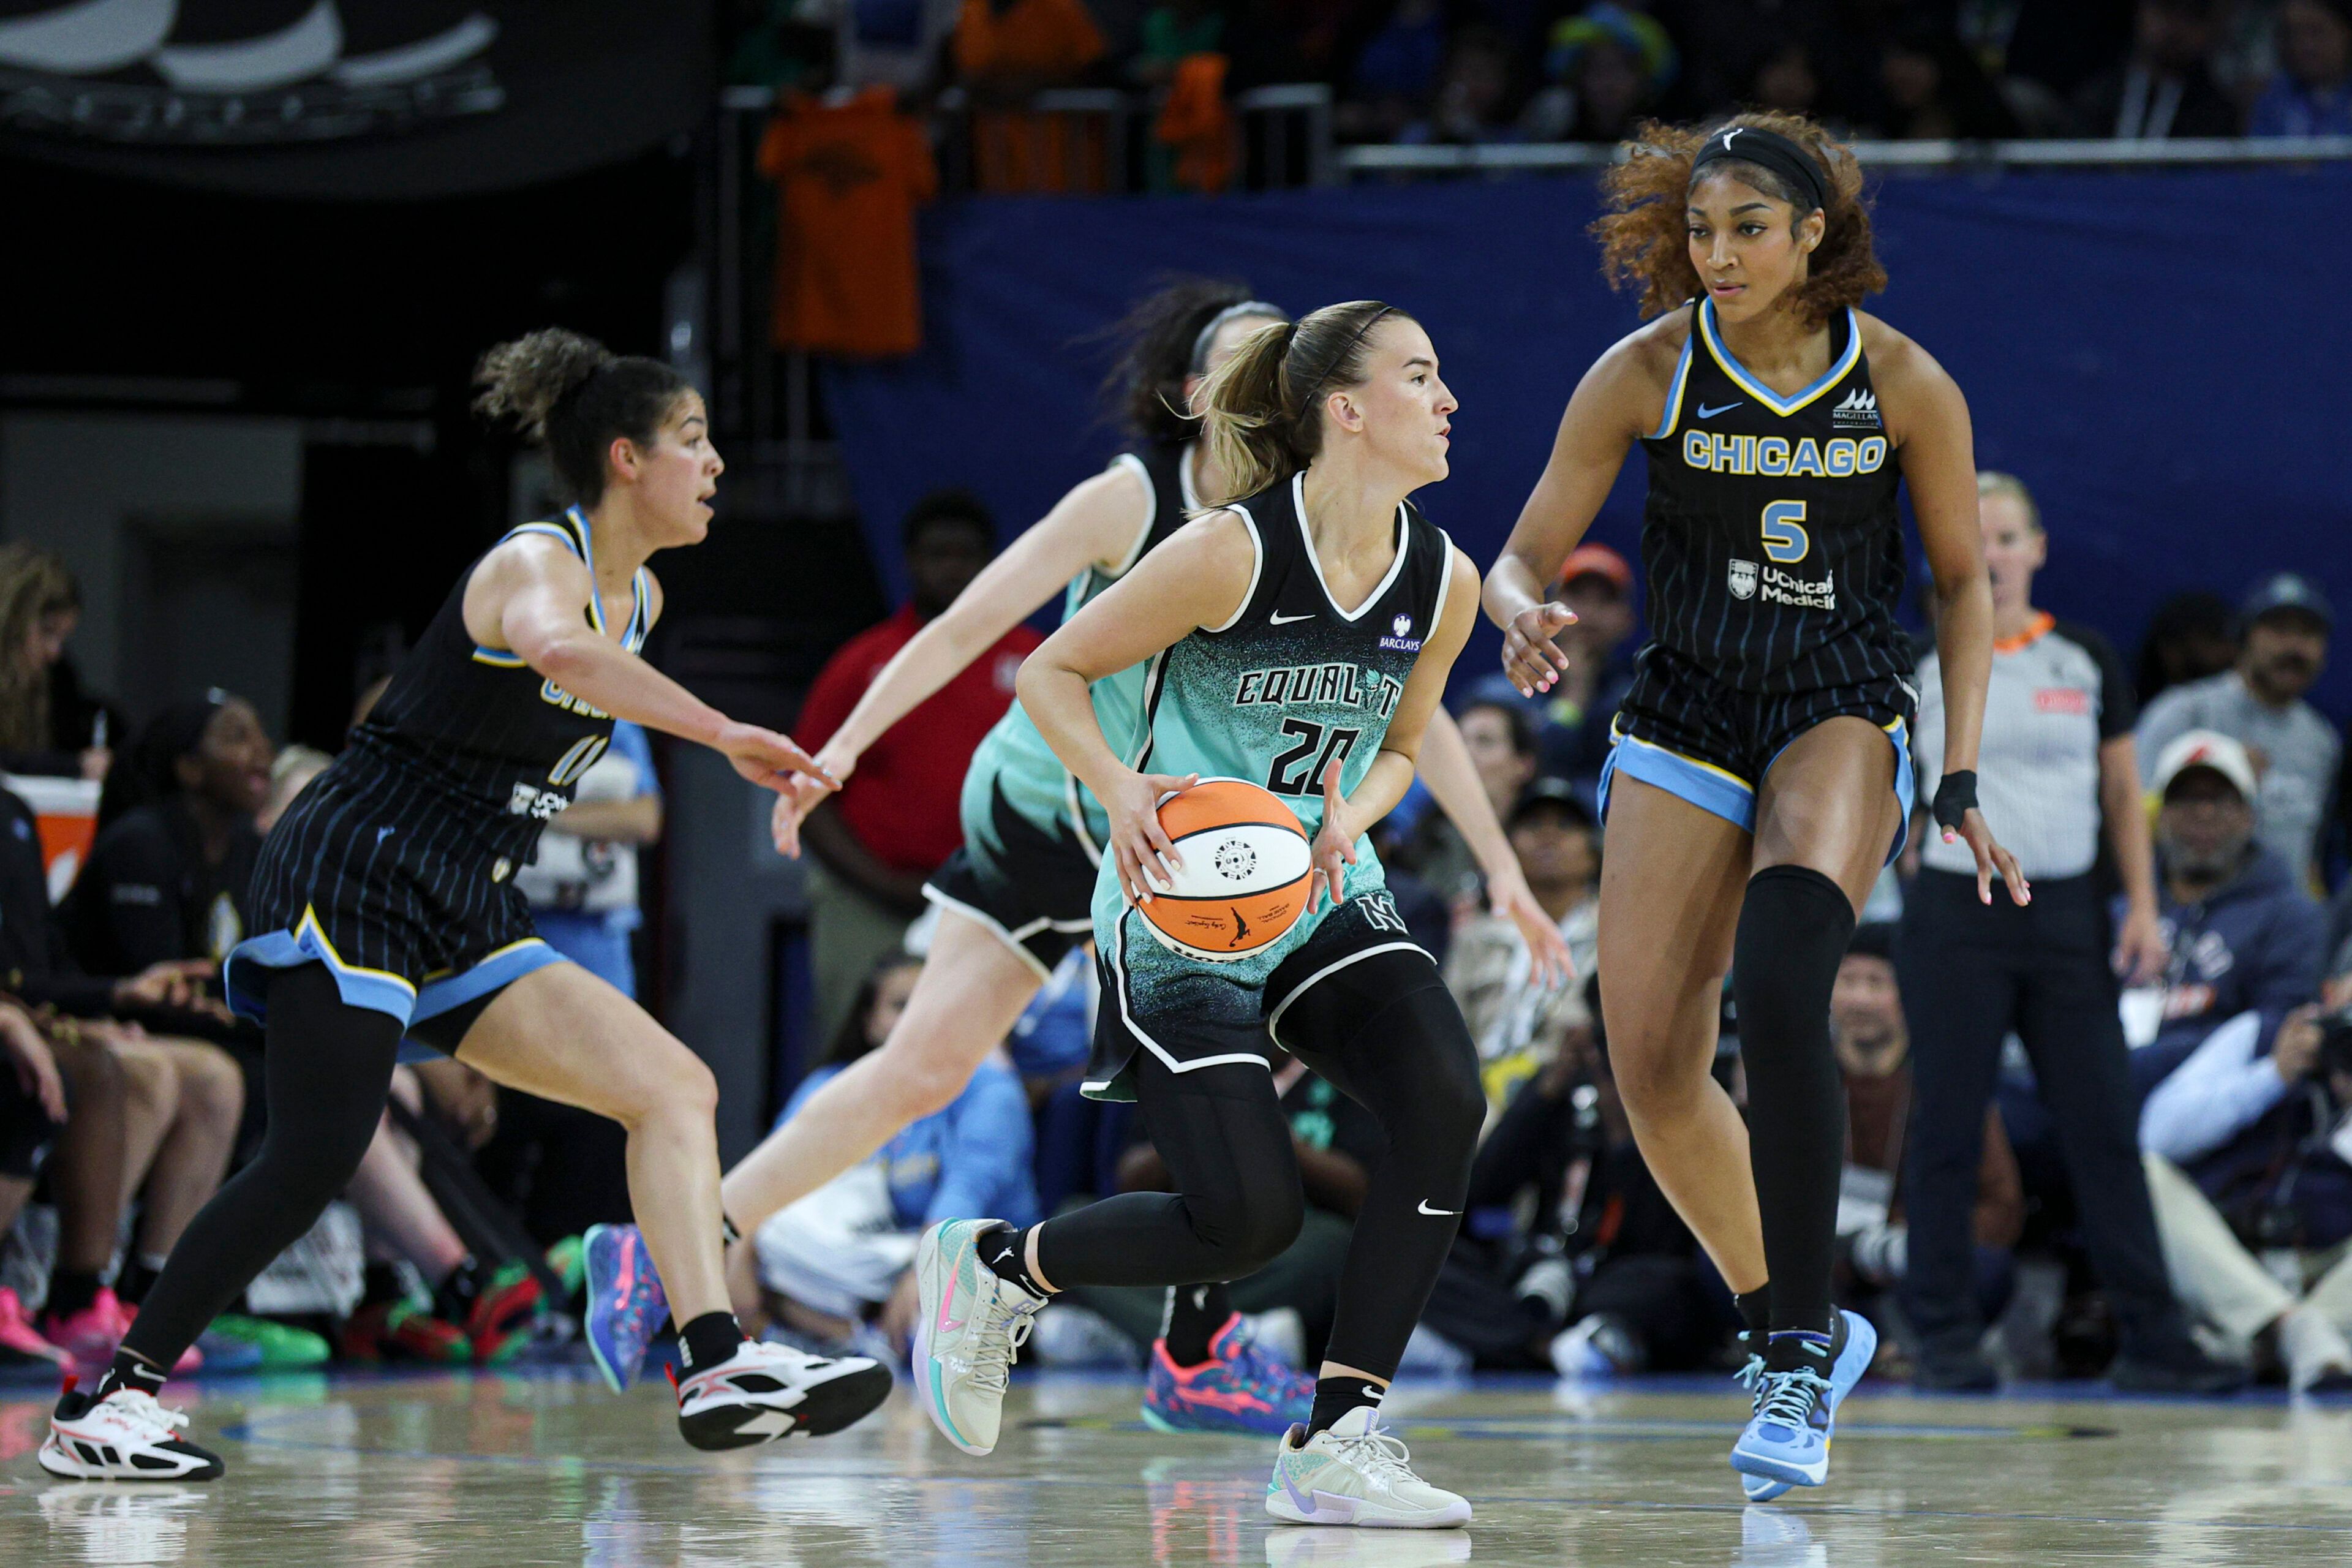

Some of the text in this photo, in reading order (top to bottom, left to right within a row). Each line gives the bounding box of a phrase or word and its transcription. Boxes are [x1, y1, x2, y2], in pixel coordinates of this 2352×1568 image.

[1683, 429, 1887, 478] CHICAGO
[1761, 500, 1809, 564] 5
[1379, 637, 1420, 651] BARCLAYS
[1266, 716, 1362, 798] 20
